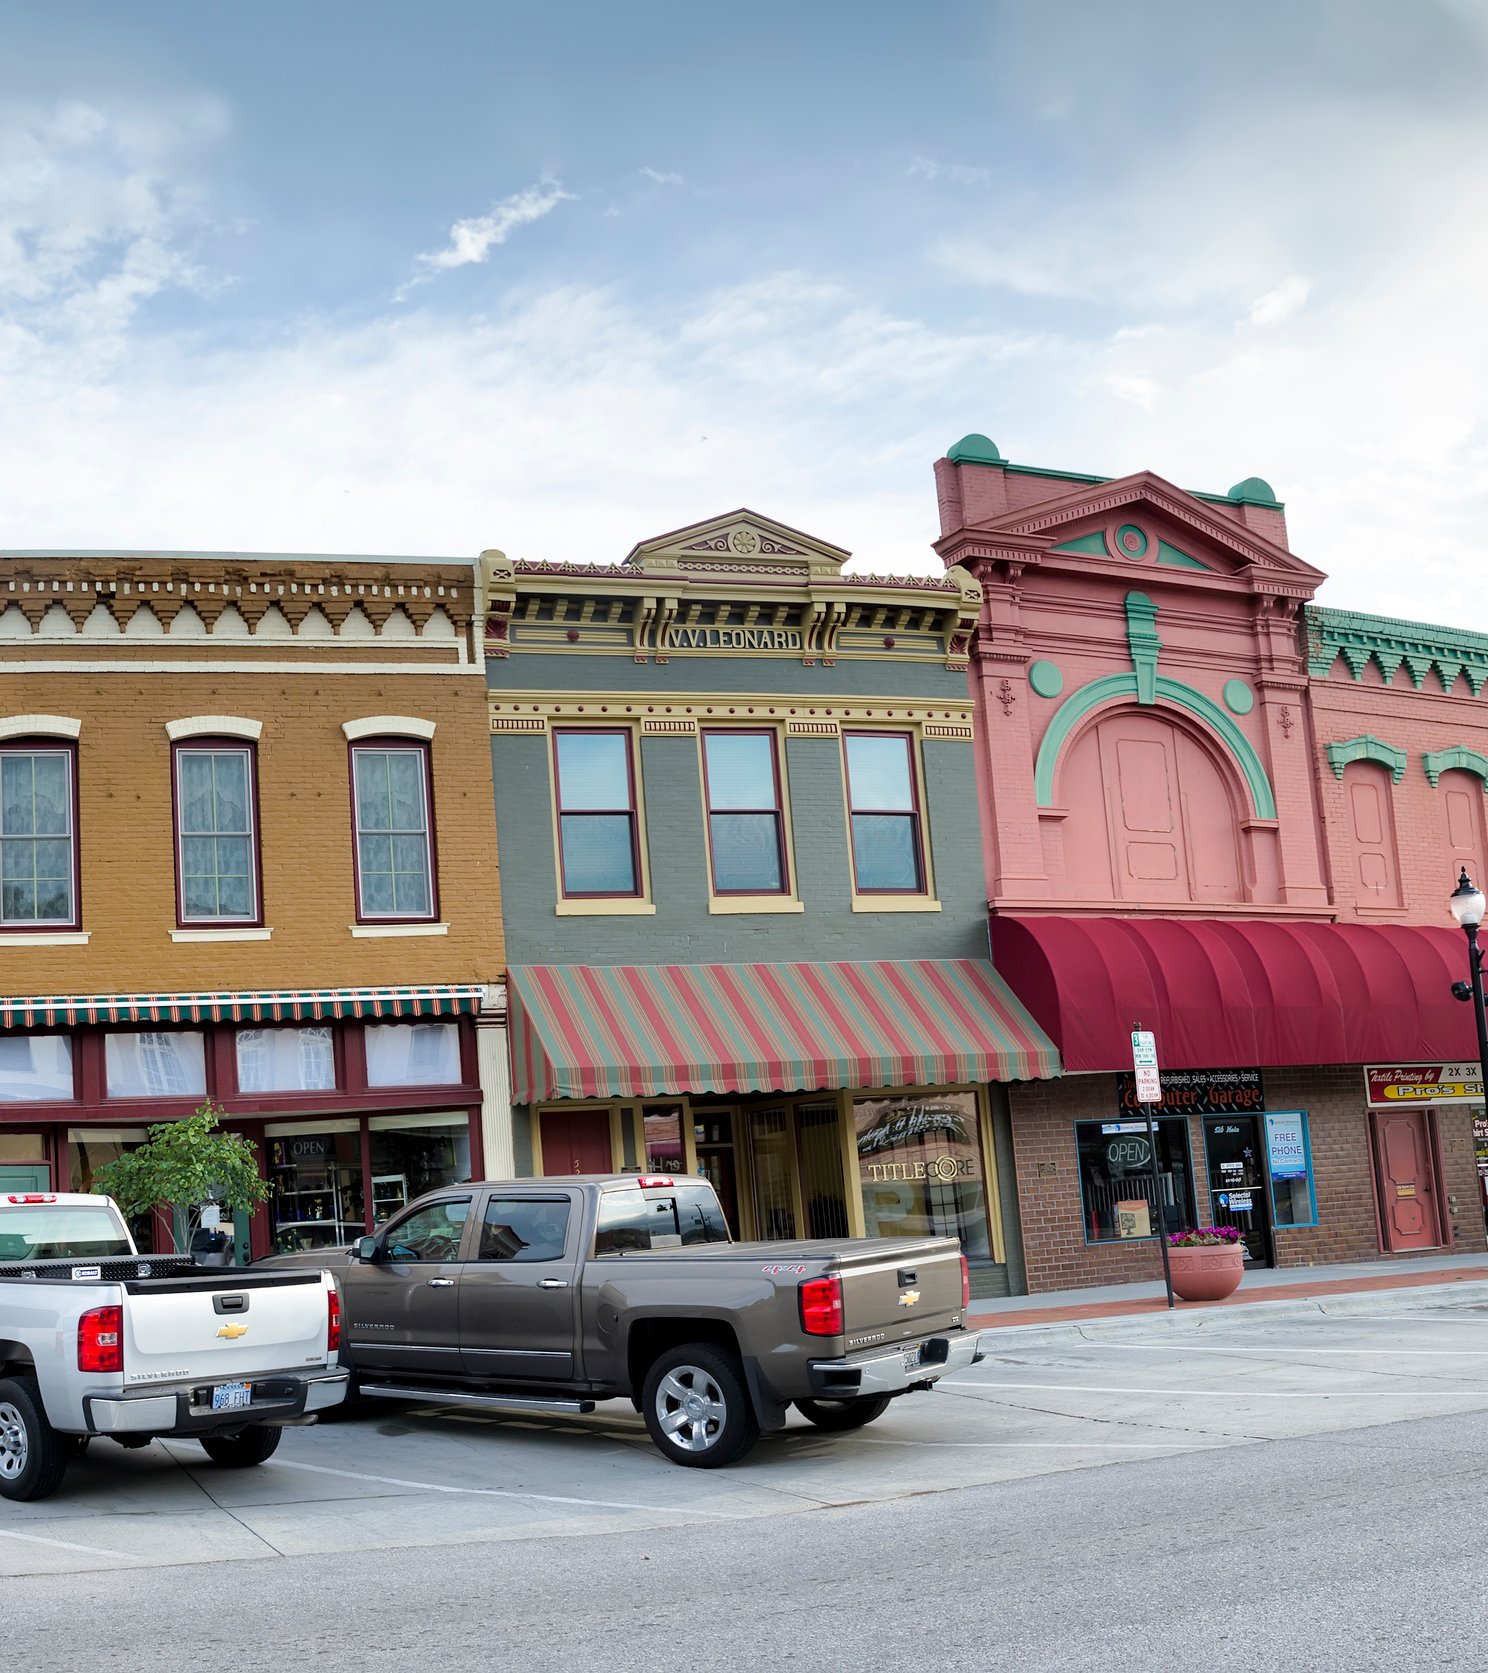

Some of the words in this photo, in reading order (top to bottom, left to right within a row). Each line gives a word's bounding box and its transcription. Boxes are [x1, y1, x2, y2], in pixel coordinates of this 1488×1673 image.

[1133, 1034, 1139, 1045] 3
[1370, 1070, 1393, 1082] Textile
[1394, 1069, 1423, 1084] Printing
[1424, 1069, 1435, 1082] by
[1448, 1067, 1461, 1076] 2X
[1465, 1067, 1477, 1076] 3X
[1160, 1076, 1191, 1085] REFURBISHED
[1192, 1075, 1207, 1084] SALES
[1209, 1074, 1238, 1083] ACCESSORIES
[1241, 1073, 1259, 1082] SERVICE
[1397, 1085, 1456, 1097] Pro's
[1125, 1089, 1197, 1110] Coputer
[1209, 1086, 1260, 1107] Garage
[1274, 1132, 1296, 1142] FREE
[293, 1141, 325, 1156] OPEN
[1108, 1142, 1145, 1162] OPEN
[1272, 1145, 1302, 1155] PHONE
[868, 1155, 975, 1182] TITLECORE
[353, 1322, 395, 1331] SILVERADO
[848, 1333, 885, 1347] SILVERADO
[130, 1368, 190, 1381] SILVERADO
